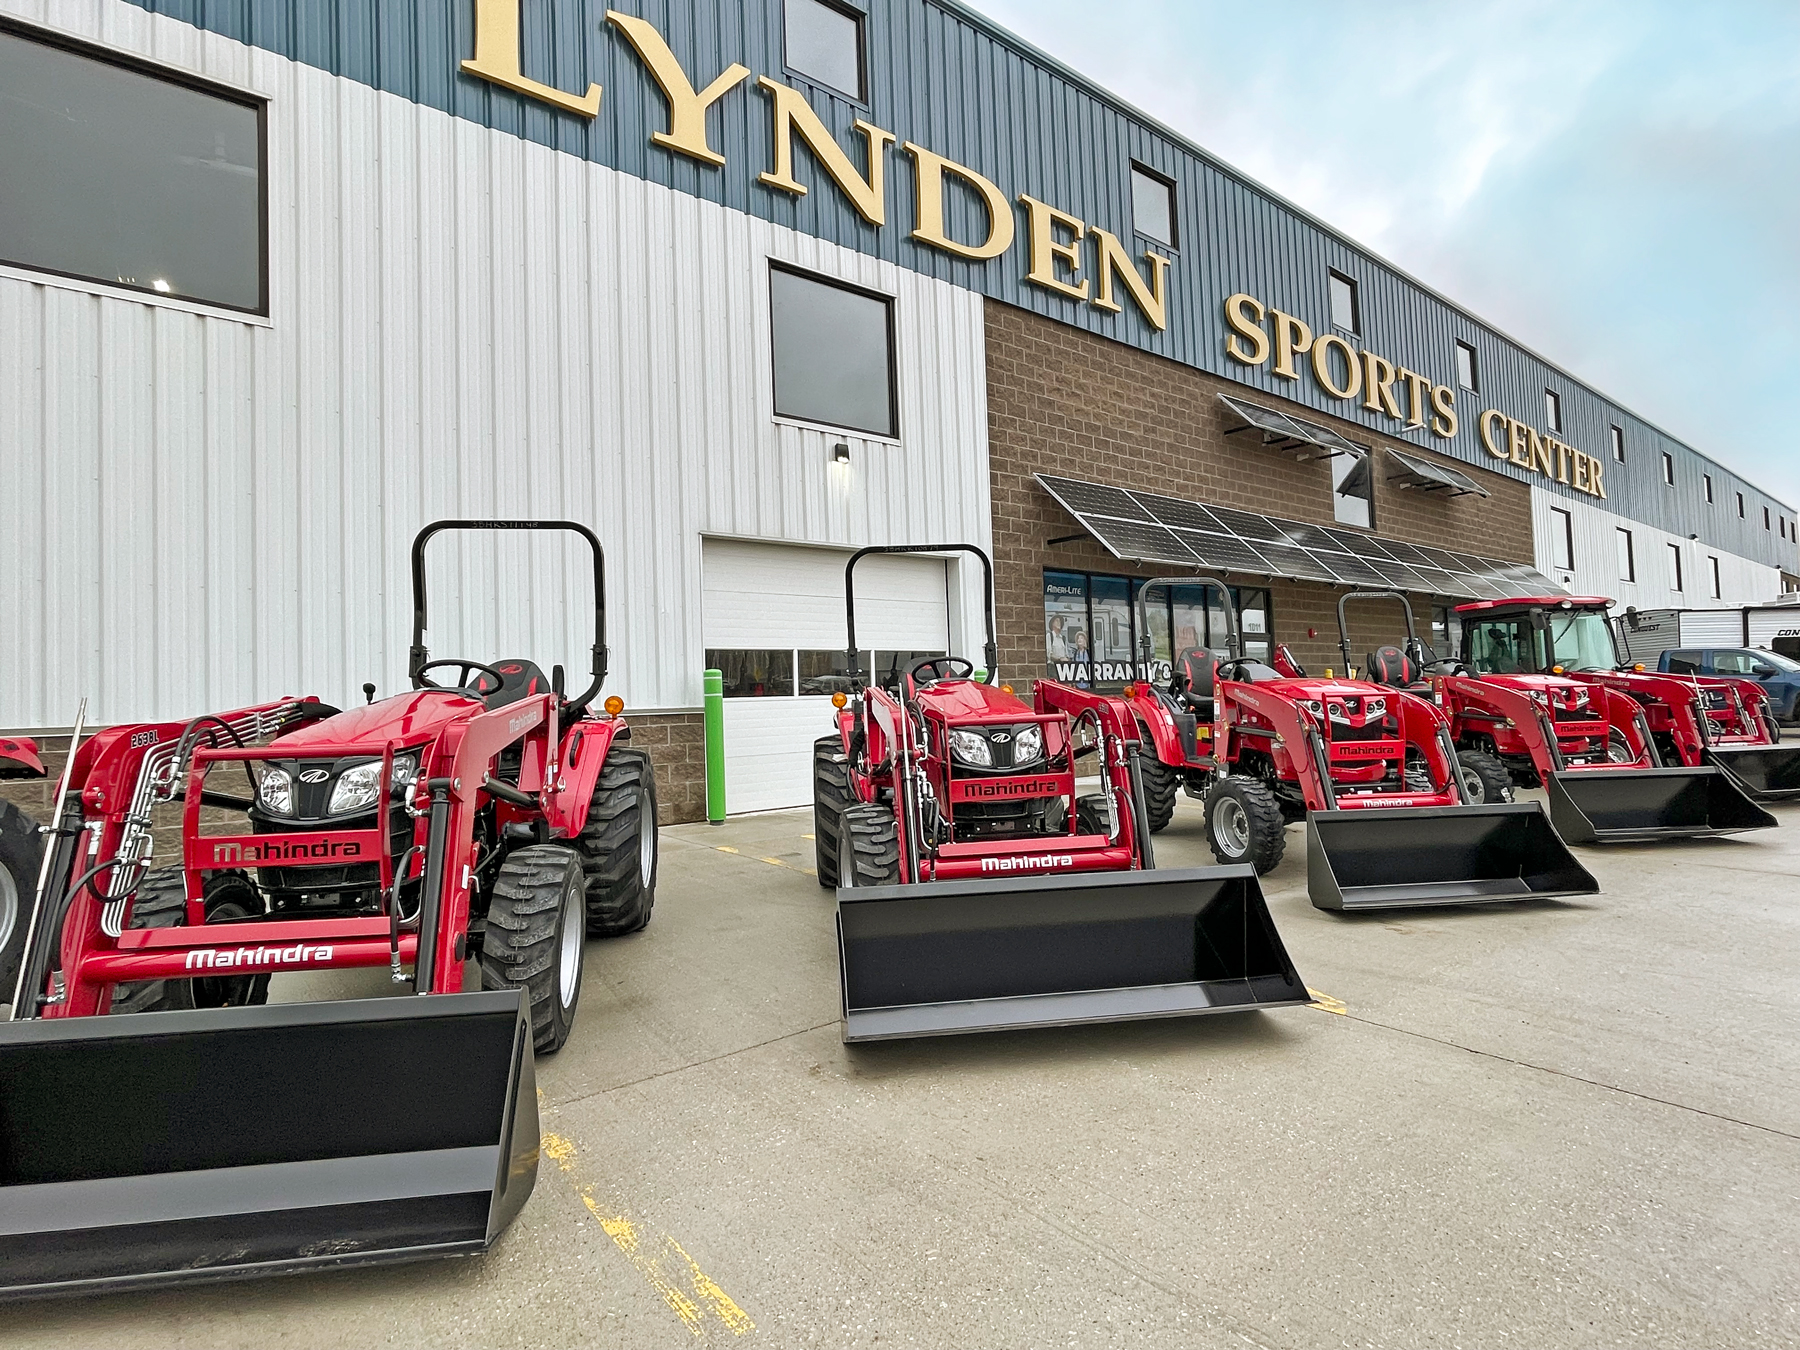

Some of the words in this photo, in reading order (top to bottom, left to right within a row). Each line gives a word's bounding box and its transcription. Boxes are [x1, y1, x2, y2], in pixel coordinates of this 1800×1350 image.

[1225, 292, 1459, 439] SPORTS
[1479, 408, 1608, 500] CENTER
[131, 729, 159, 749] 2638L
[1339, 746, 1394, 756] Mahindra
[964, 780, 1058, 797] Mahindra
[1362, 799, 1413, 808] Mahindra
[213, 839, 361, 863] Mahindra
[981, 854, 1073, 871] Mahindra
[185, 944, 333, 969] Mahindra
